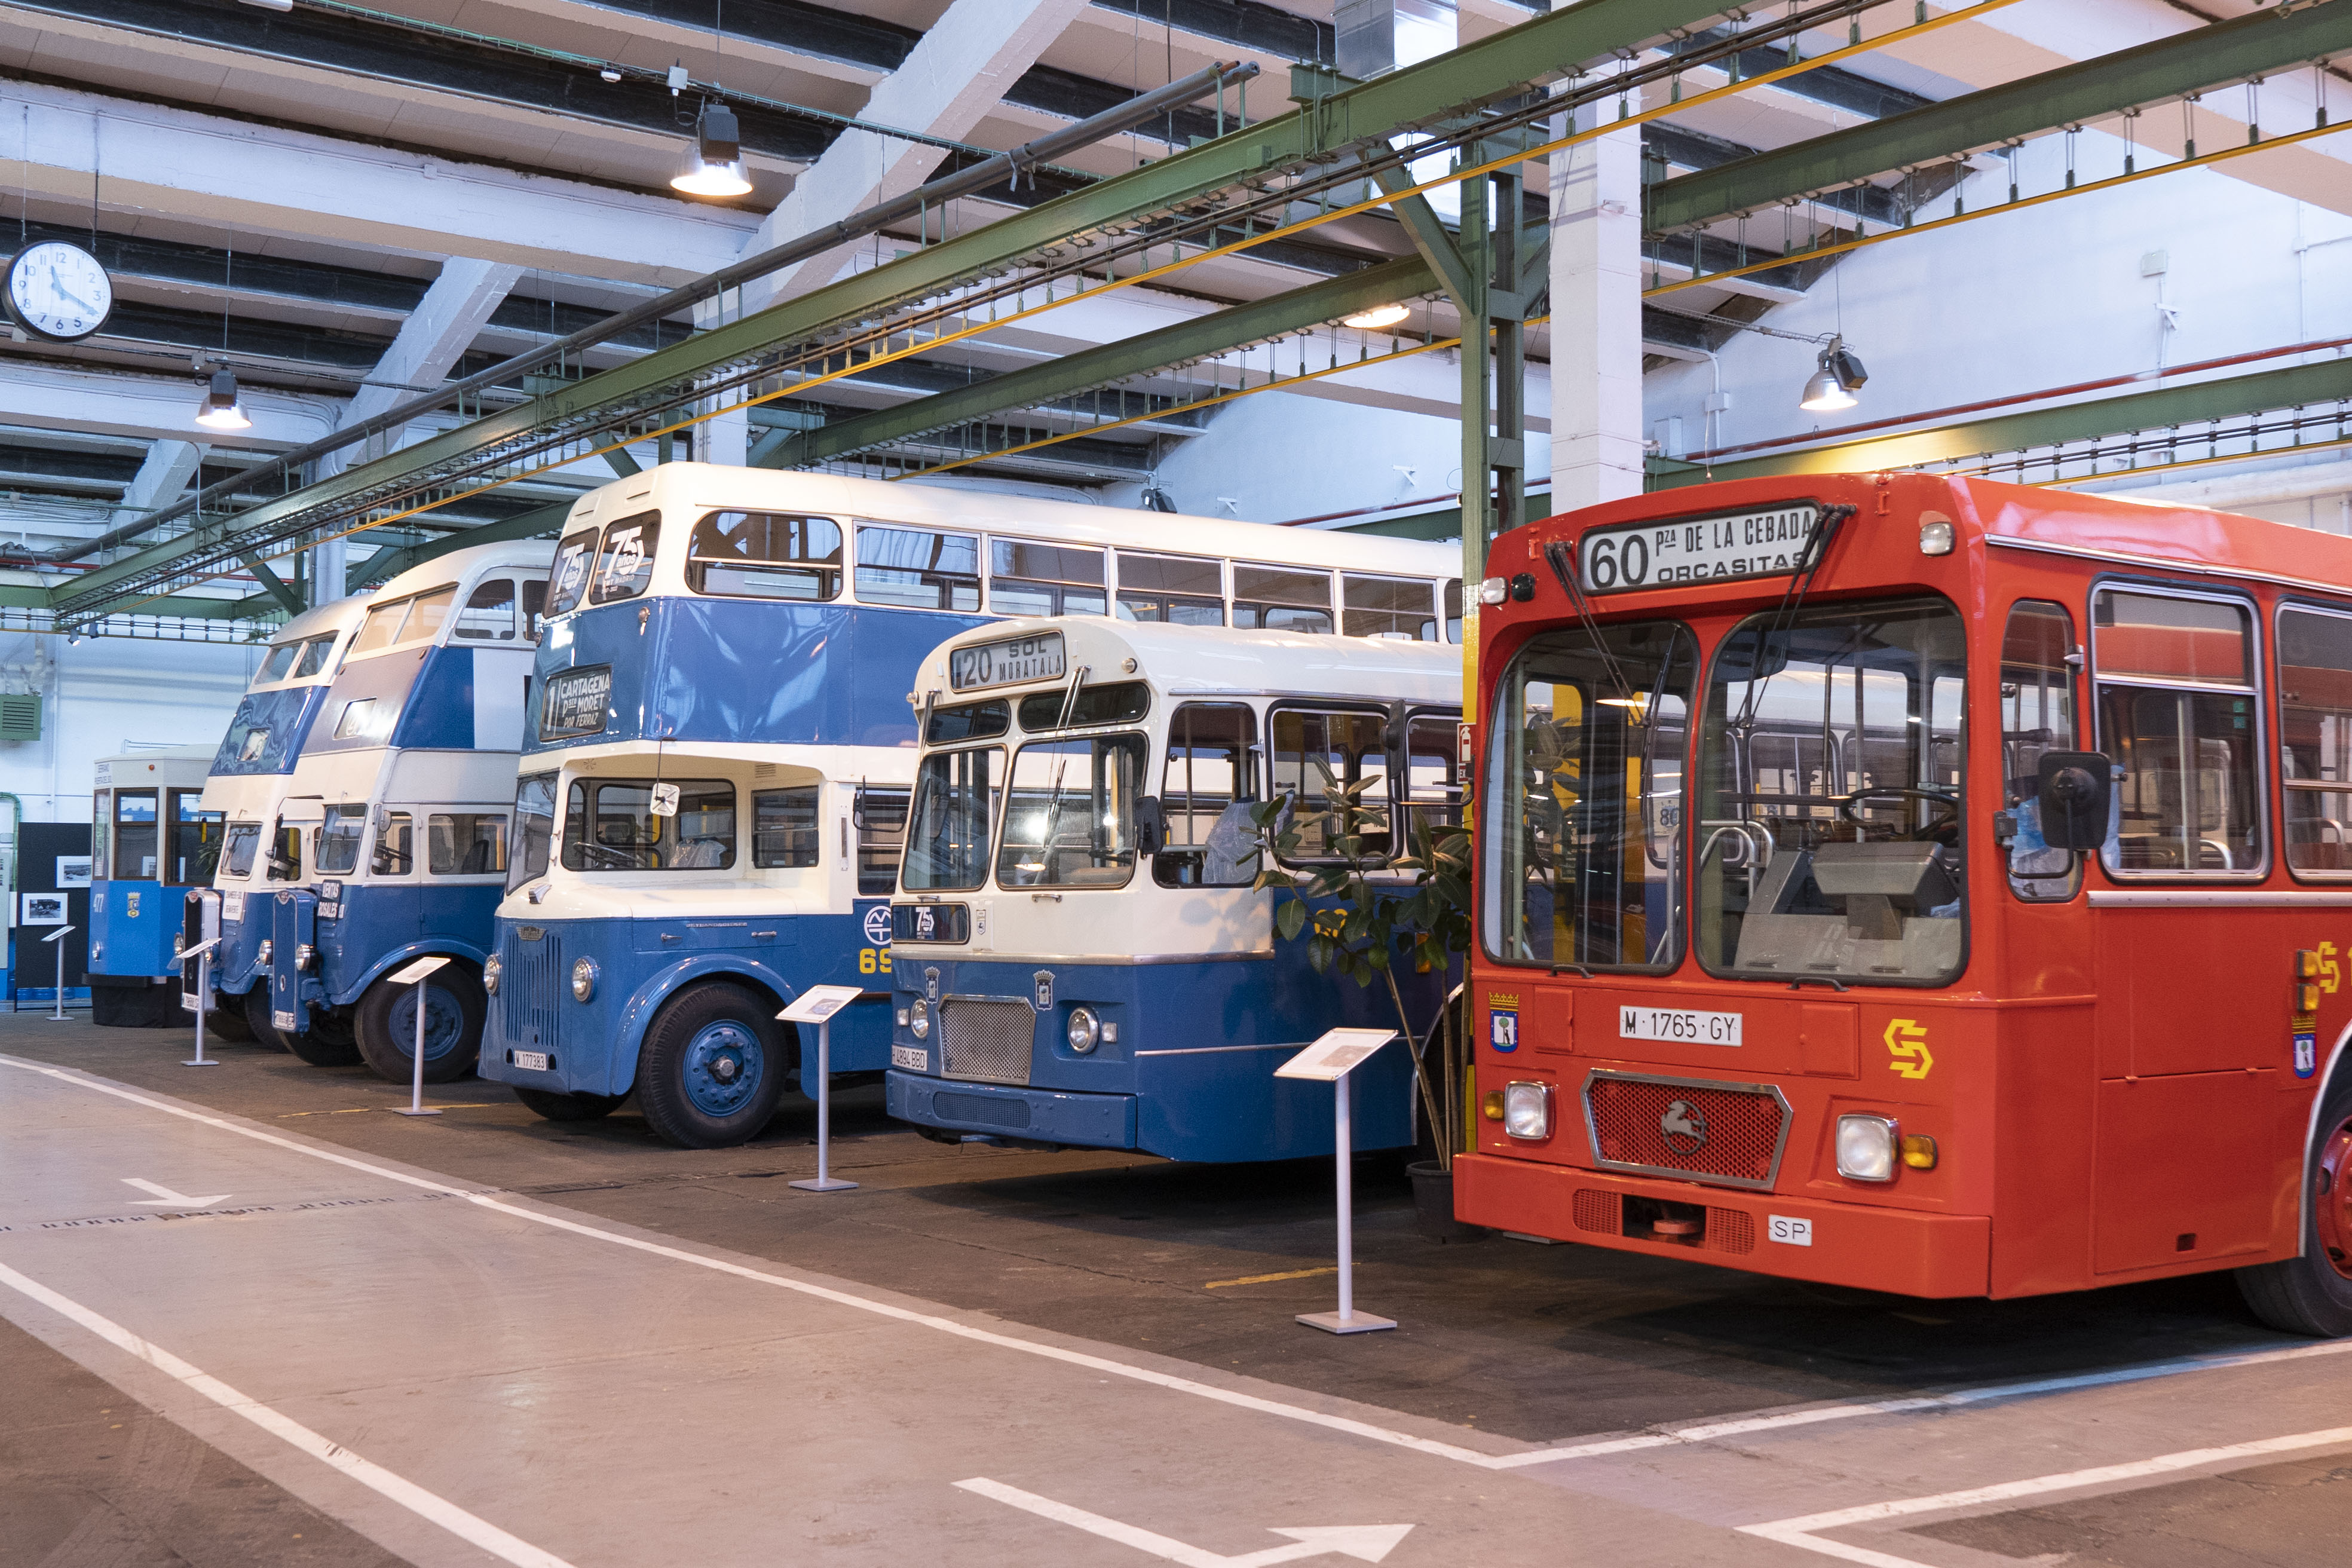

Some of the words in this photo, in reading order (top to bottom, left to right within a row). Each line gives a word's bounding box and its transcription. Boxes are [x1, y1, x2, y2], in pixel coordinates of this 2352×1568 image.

[40, 254, 47, 265] 11
[56, 252, 66, 264] 12
[76, 258, 80, 269] 1
[24, 265, 36, 276] 10
[88, 272, 96, 283] 2
[19, 280, 26, 290] 9
[23, 298, 31, 309] 8
[93, 290, 102, 301] 3
[39, 311, 47, 323] 7
[56, 319, 64, 330] 6
[74, 317, 82, 327] 5
[1685, 525, 1703, 553] DE
[1714, 522, 1734, 549] LA
[1744, 511, 1811, 545] CEBADA
[605, 526, 645, 579] 75
[617, 553, 636, 567] años
[1590, 534, 1648, 589] 60
[556, 543, 585, 593] 75
[1657, 551, 1805, 583] ORCASITAS
[1009, 639, 1046, 658] SOL
[956, 647, 992, 689] 120
[999, 655, 1061, 681] MORATALA
[561, 673, 610, 699] CARTAGENA
[547, 687, 556, 731] 1
[577, 694, 605, 713] MORET
[564, 716, 575, 728] POR
[576, 712, 599, 727] FERRAZ
[915, 906, 935, 932] 75
[896, 1049, 910, 1066] 4894
[912, 1051, 925, 1068] BBD
[1774, 1220, 1806, 1241] SP
